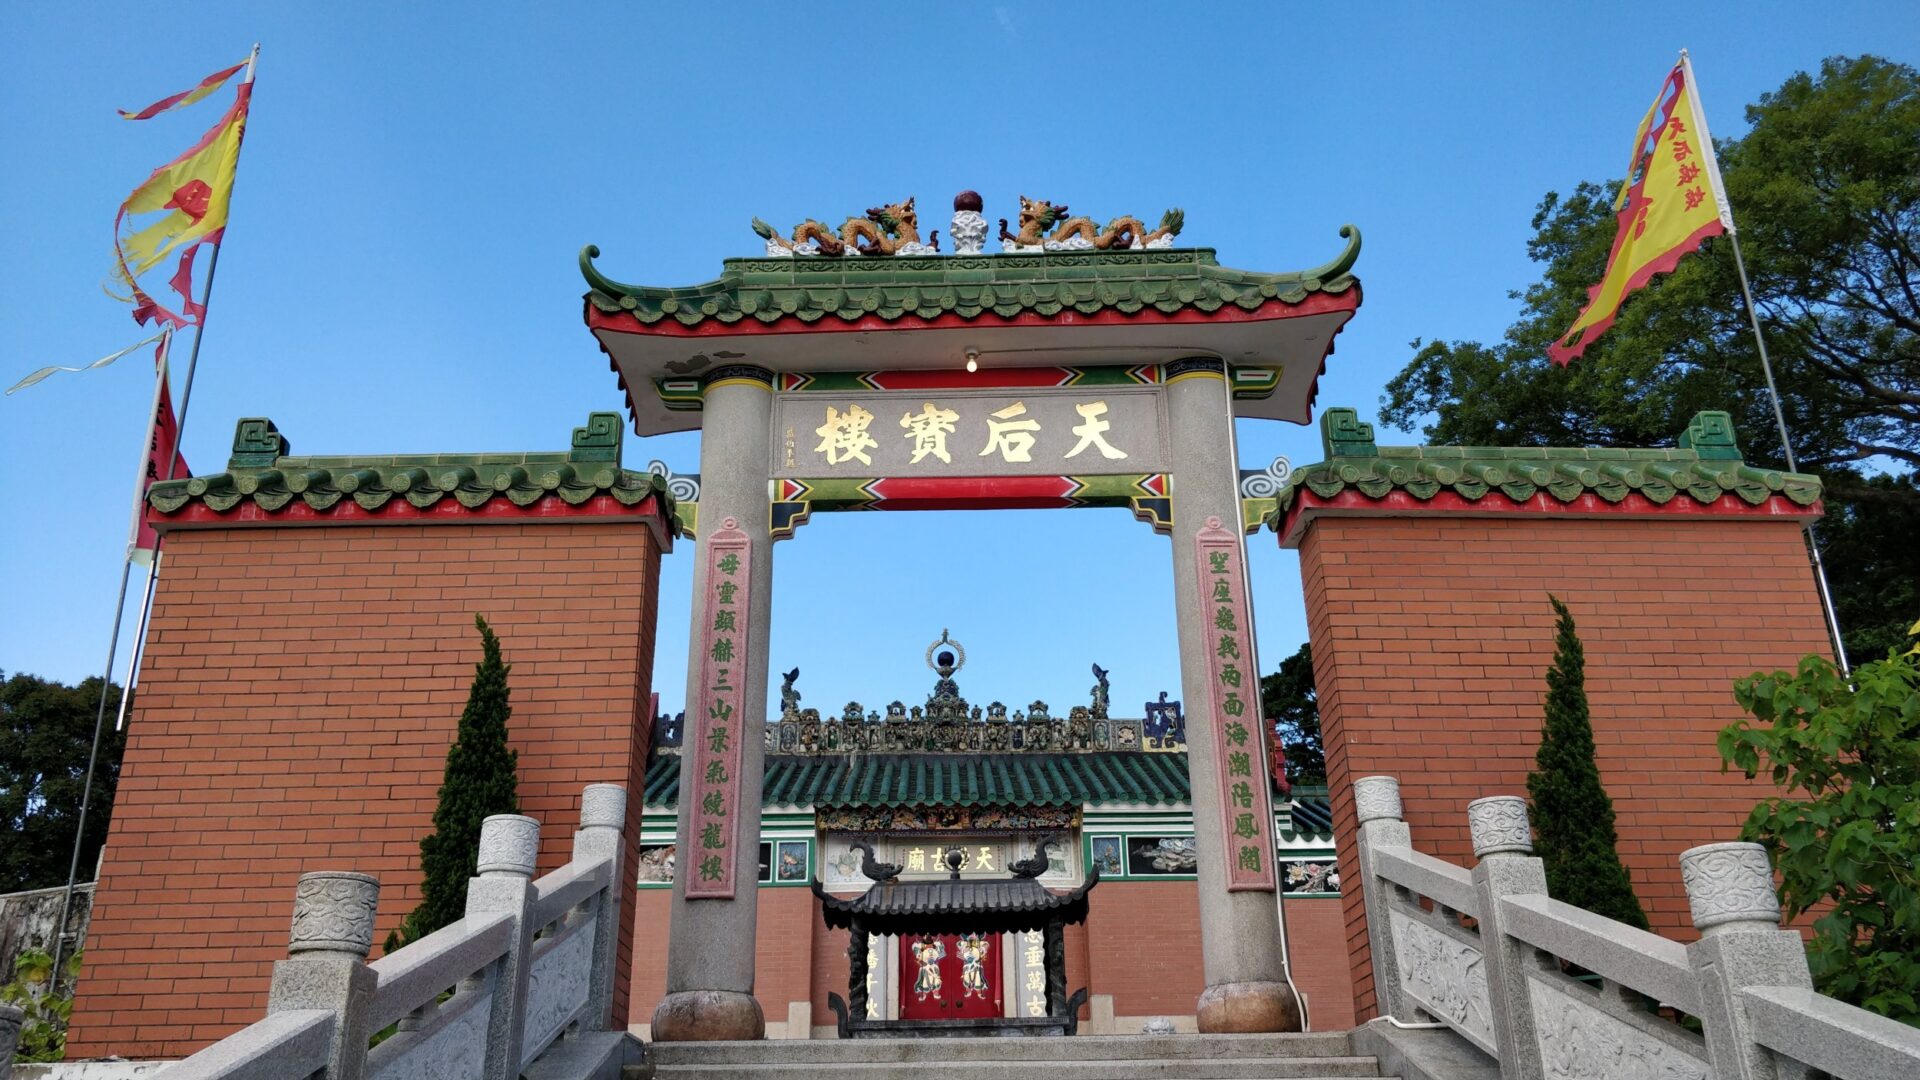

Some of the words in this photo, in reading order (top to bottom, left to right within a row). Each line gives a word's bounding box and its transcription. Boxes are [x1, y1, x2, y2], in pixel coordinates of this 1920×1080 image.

[814, 400, 1129, 467] 天后寶樓
[907, 846, 995, 872] 天古廟
